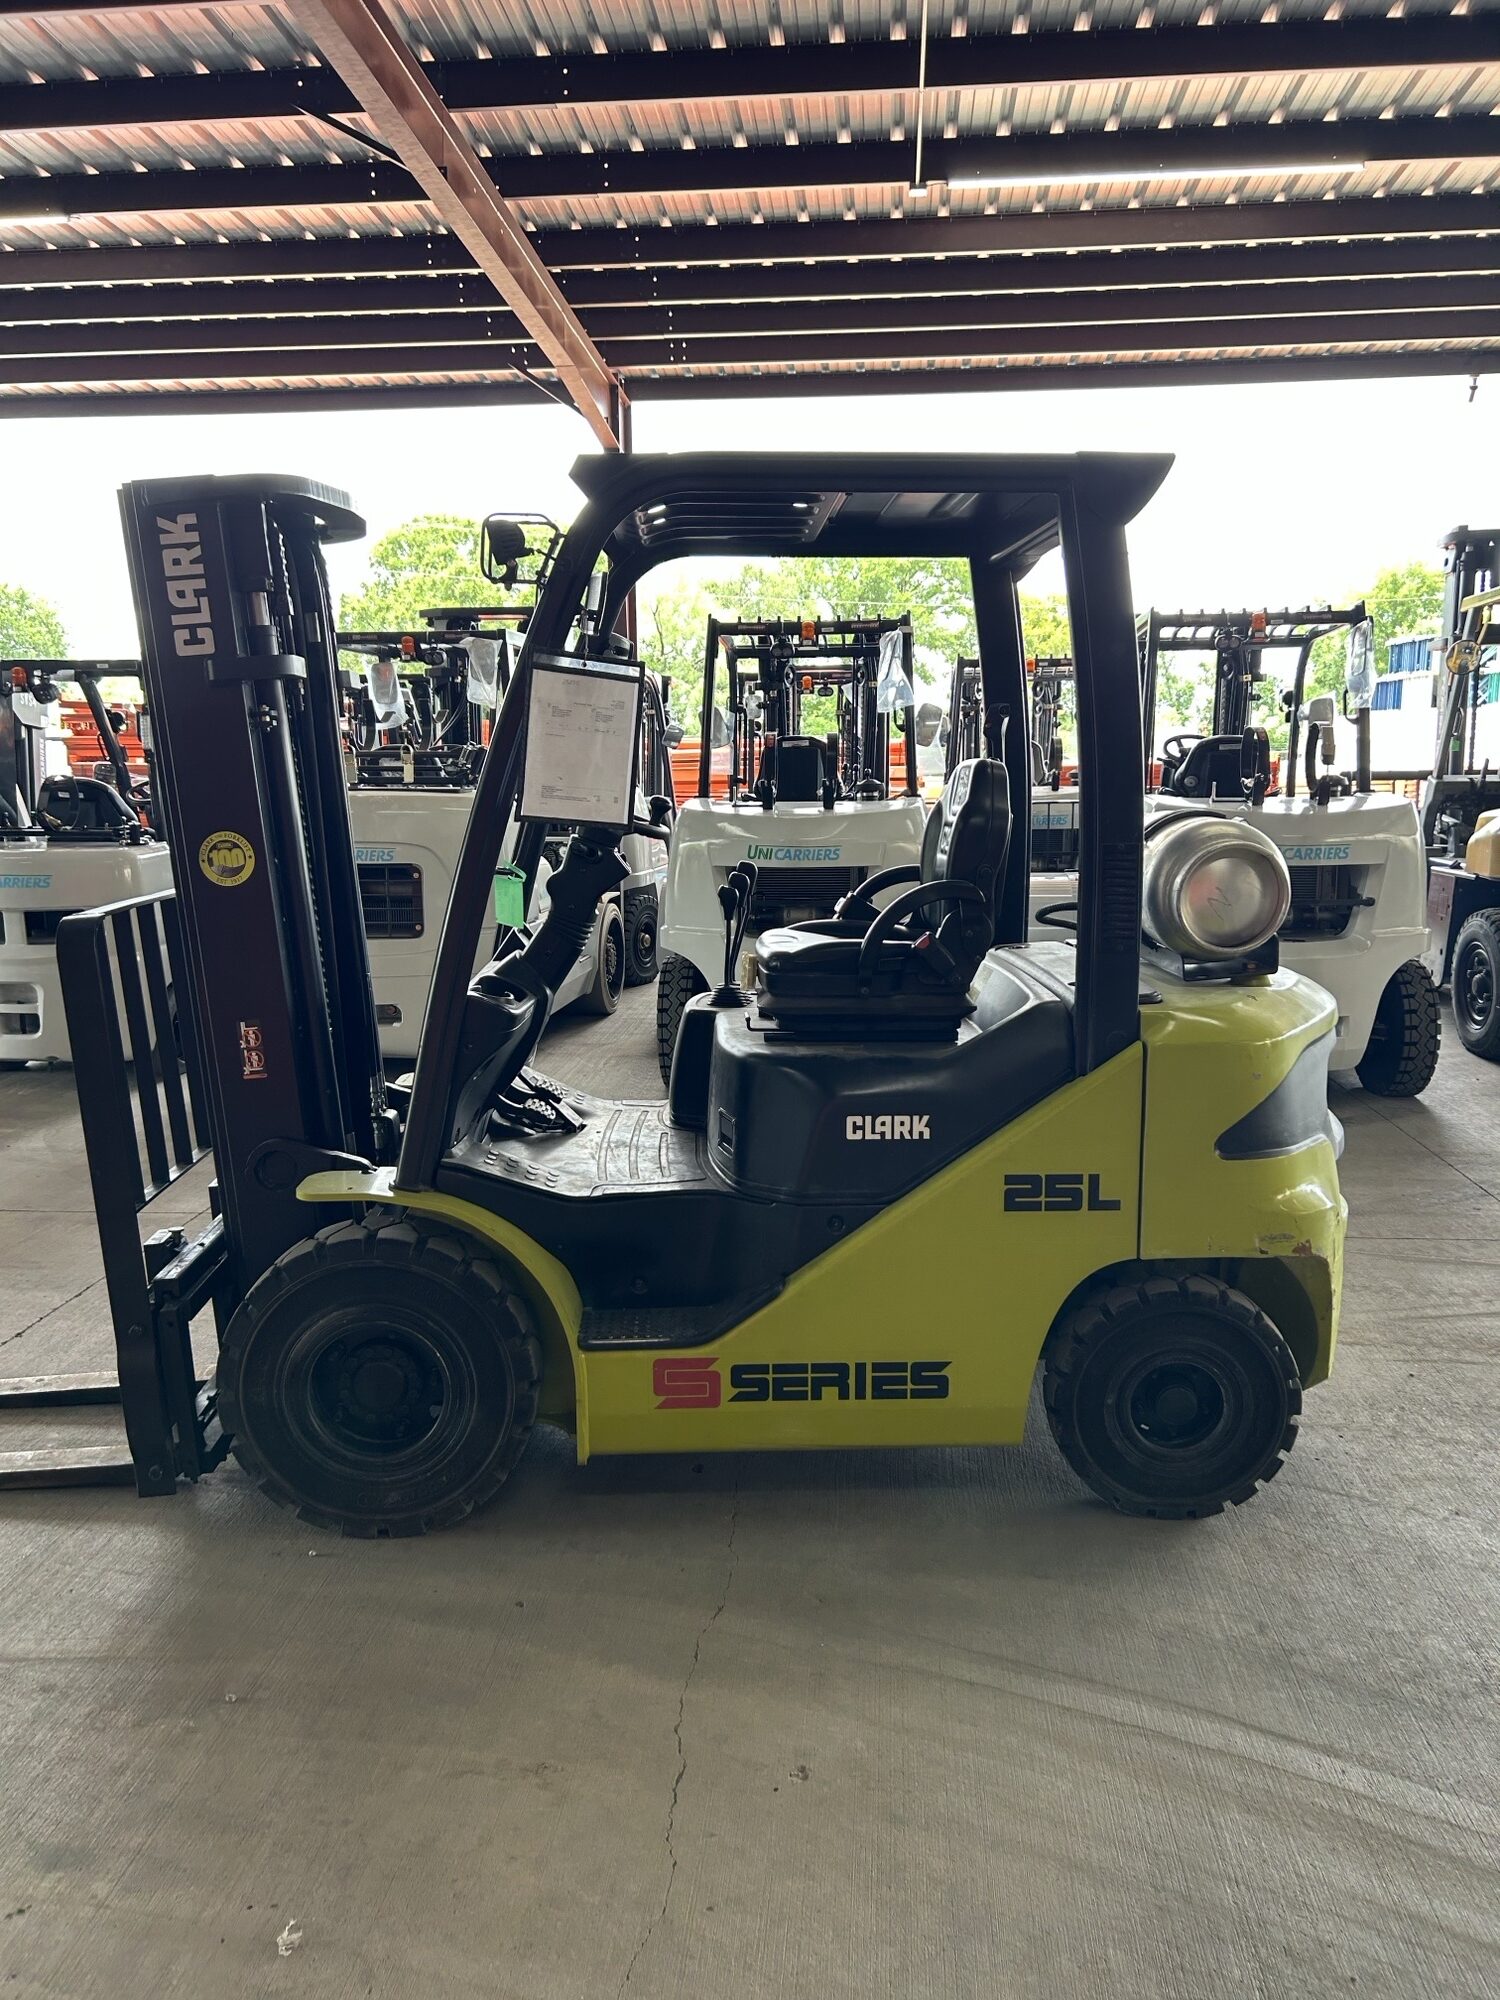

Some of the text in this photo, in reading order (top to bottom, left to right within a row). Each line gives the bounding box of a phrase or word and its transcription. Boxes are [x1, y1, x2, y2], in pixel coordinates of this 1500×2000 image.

[156, 513, 215, 656] CLARK
[209, 848, 246, 867] 100
[846, 1115, 930, 1139] CLARK
[1004, 1174, 1120, 1211] 25L
[653, 1357, 952, 1409] S SERIES
